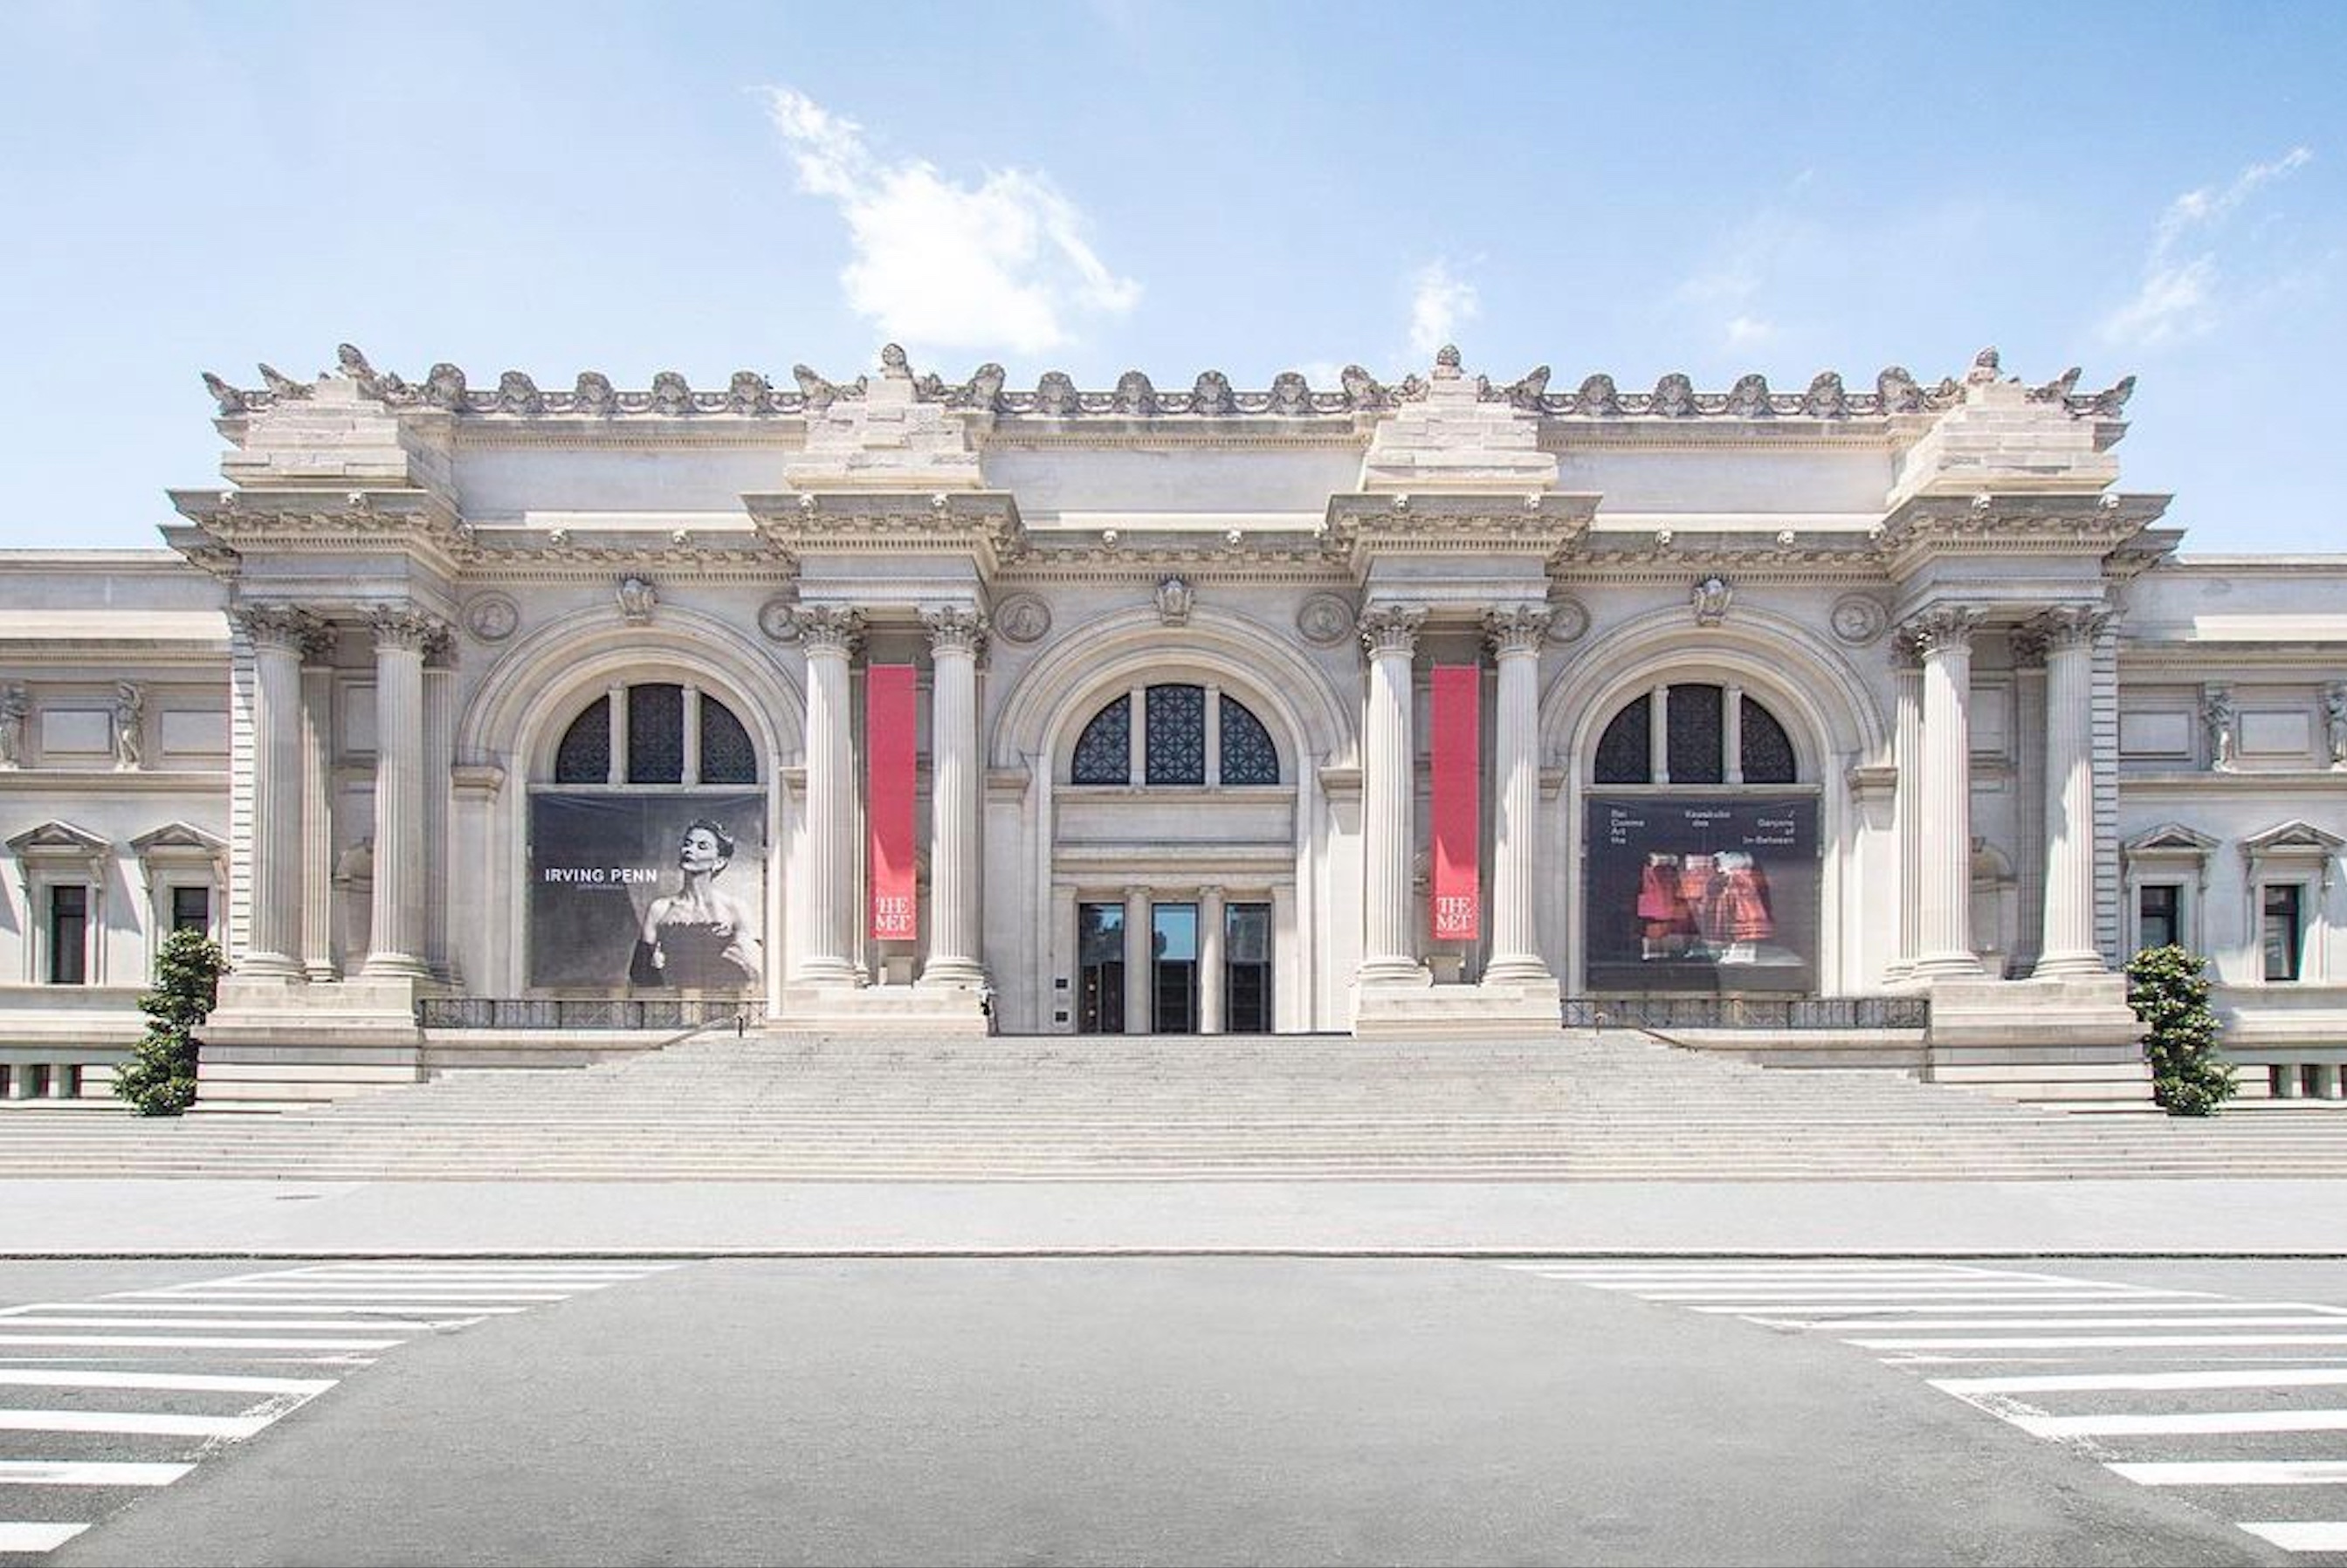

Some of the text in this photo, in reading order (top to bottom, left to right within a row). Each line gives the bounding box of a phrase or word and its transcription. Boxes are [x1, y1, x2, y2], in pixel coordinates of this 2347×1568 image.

[545, 868, 657, 883] IRVING PENN
[876, 897, 908, 914] THE
[1437, 897, 1470, 914] THE
[876, 914, 912, 931] MET
[1437, 914, 1473, 931] MET
